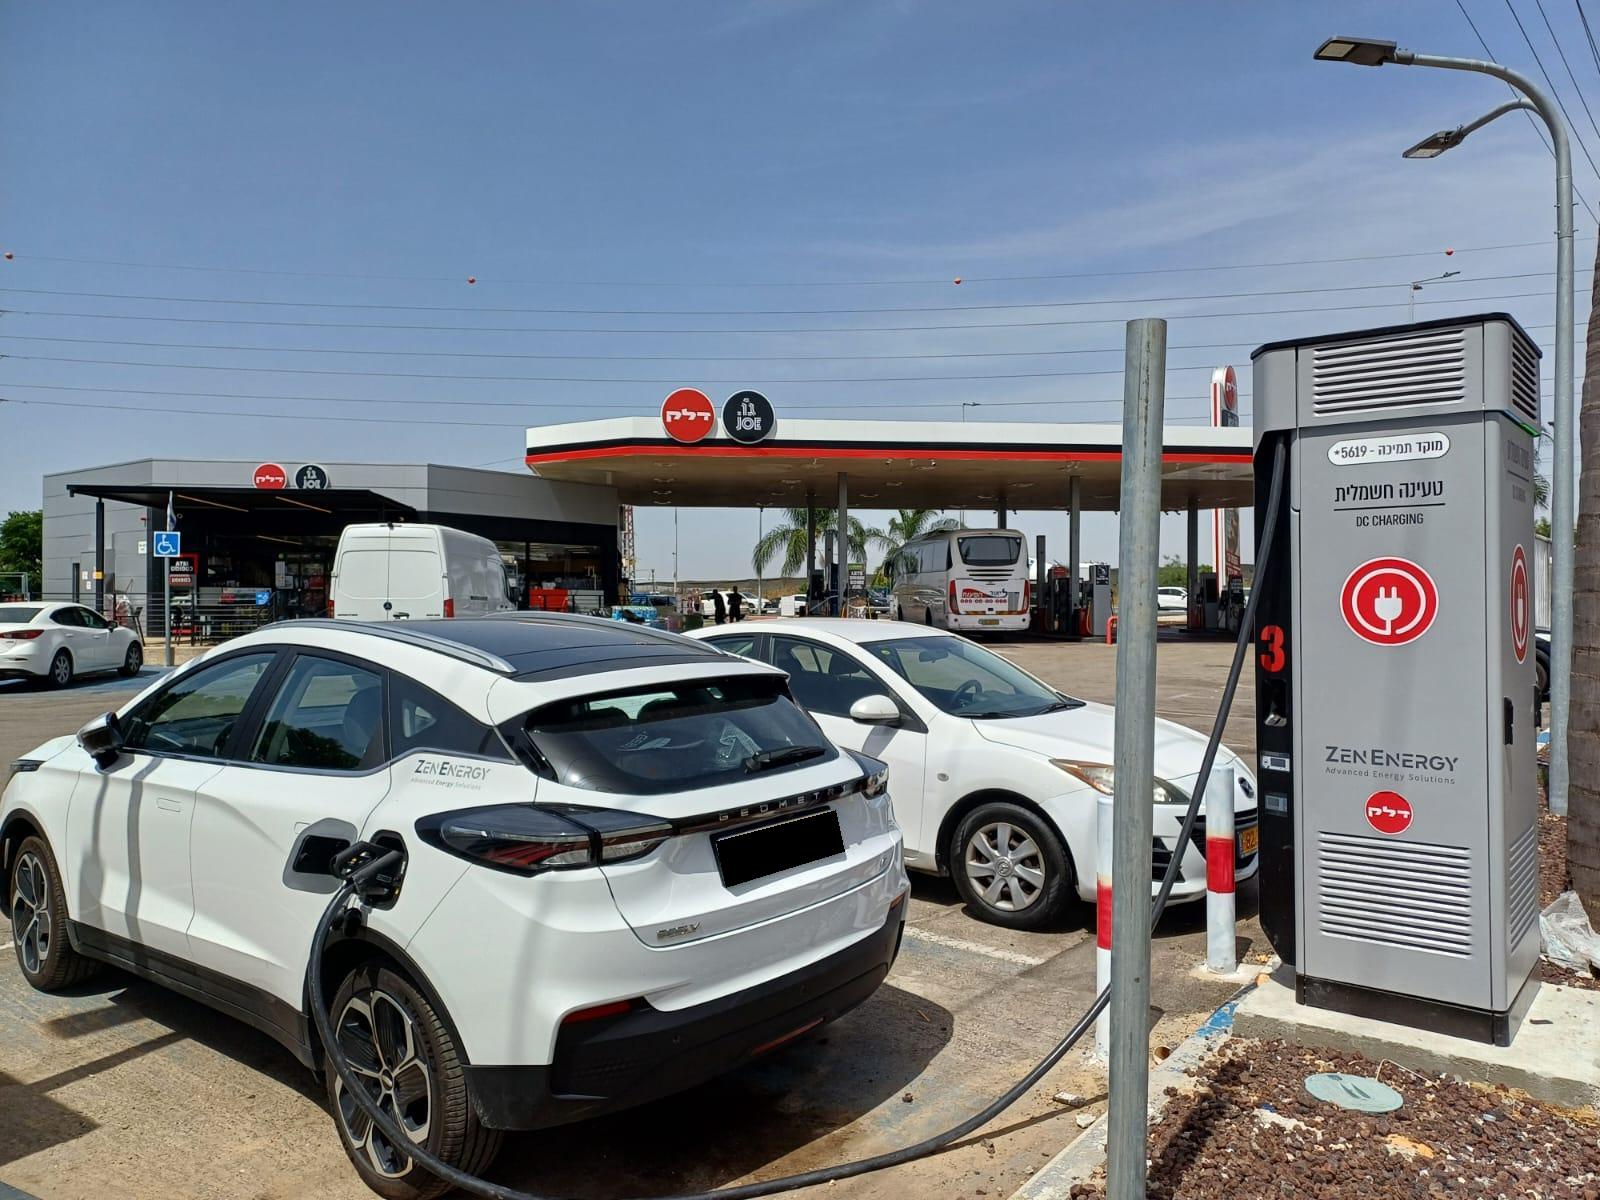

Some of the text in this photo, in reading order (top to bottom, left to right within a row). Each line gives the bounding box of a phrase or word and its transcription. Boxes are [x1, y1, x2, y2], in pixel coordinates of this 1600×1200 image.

[666, 408, 711, 422] דלק
[736, 414, 761, 431] JOE
[1378, 443, 1412, 455] תמיכה
[1416, 440, 1443, 454] מוקד
[256, 475, 284, 484] דלק
[1334, 481, 1443, 502] טעינה חשמלית
[1356, 513, 1424, 527] DC CHARGING
[1260, 624, 1286, 673] 3
[1325, 767, 1455, 785] Advanced Energy Solutions
[1368, 806, 1410, 818] דלק
